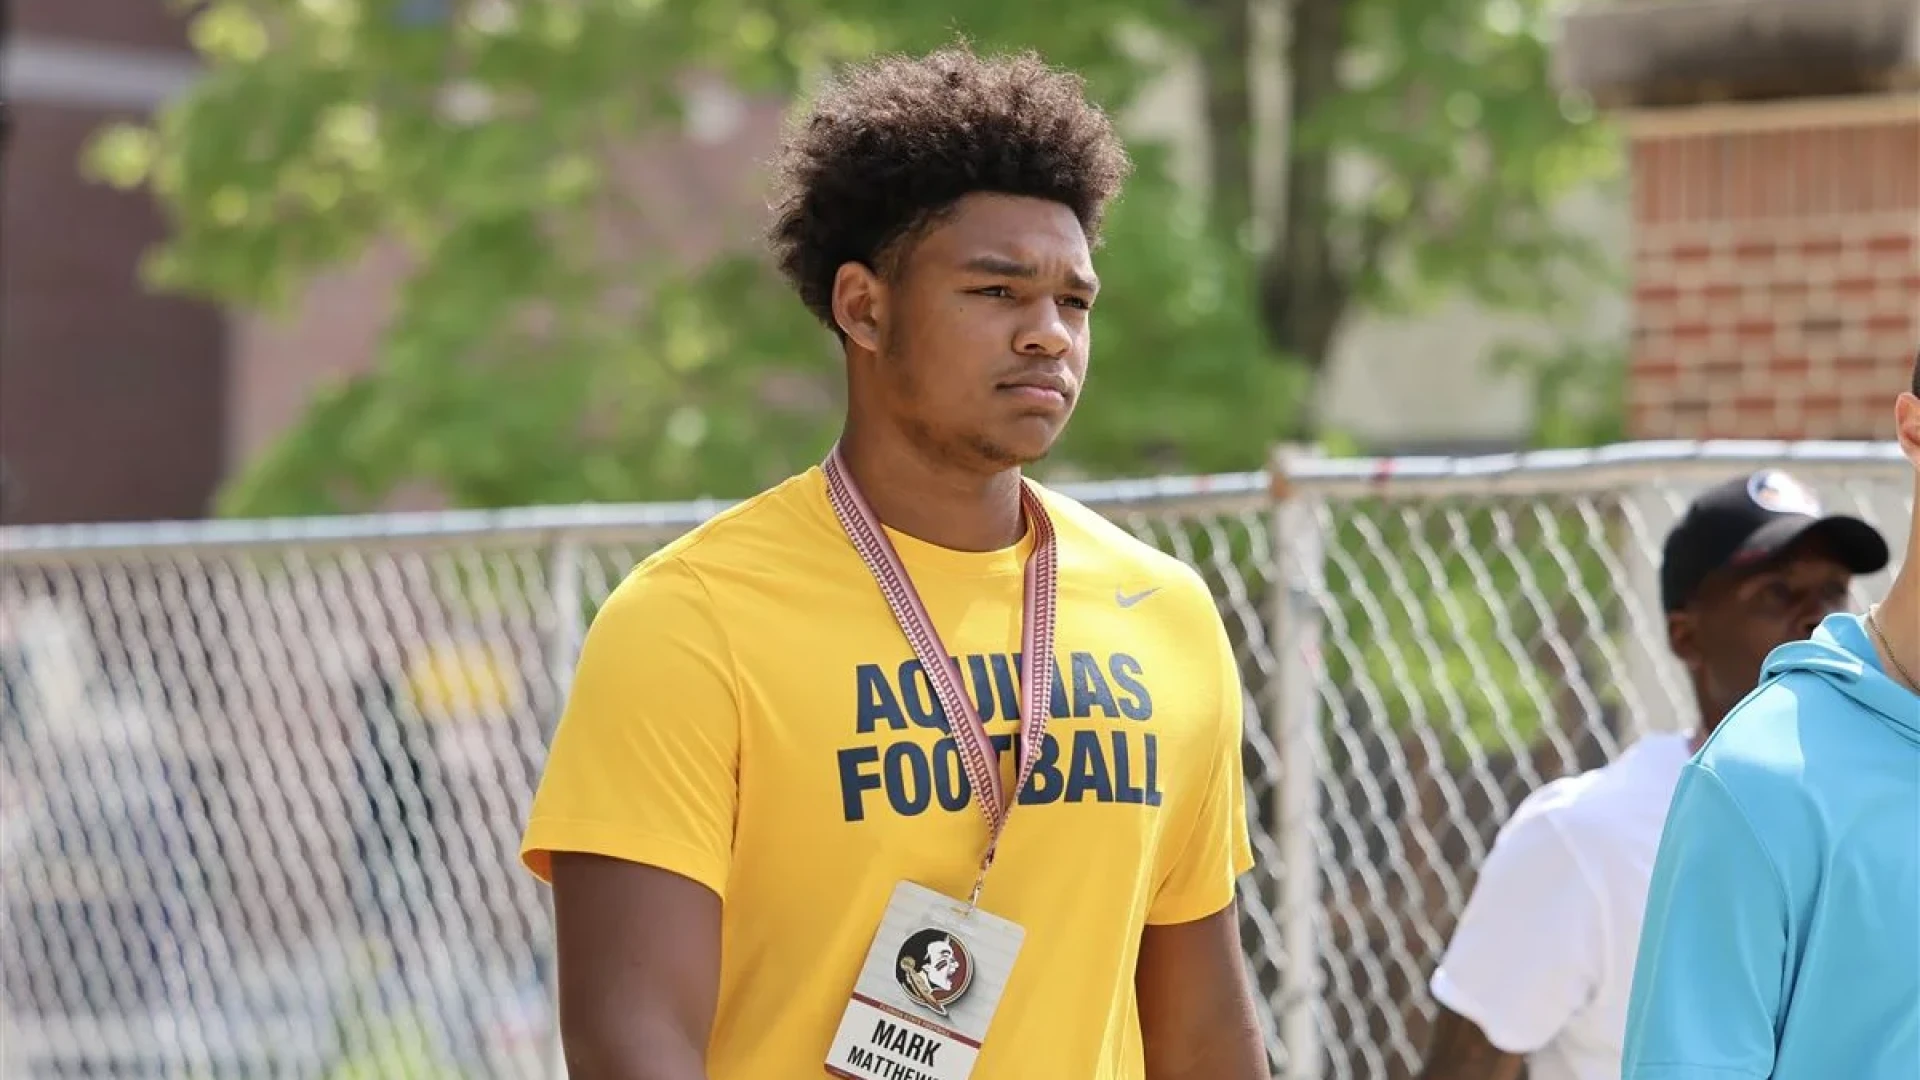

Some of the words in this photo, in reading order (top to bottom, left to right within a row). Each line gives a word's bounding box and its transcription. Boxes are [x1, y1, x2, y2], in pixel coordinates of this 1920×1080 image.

[837, 730, 1163, 822] FOOBALL
[847, 1045, 939, 1080] MATTHE
[871, 1019, 942, 1067] MARK
